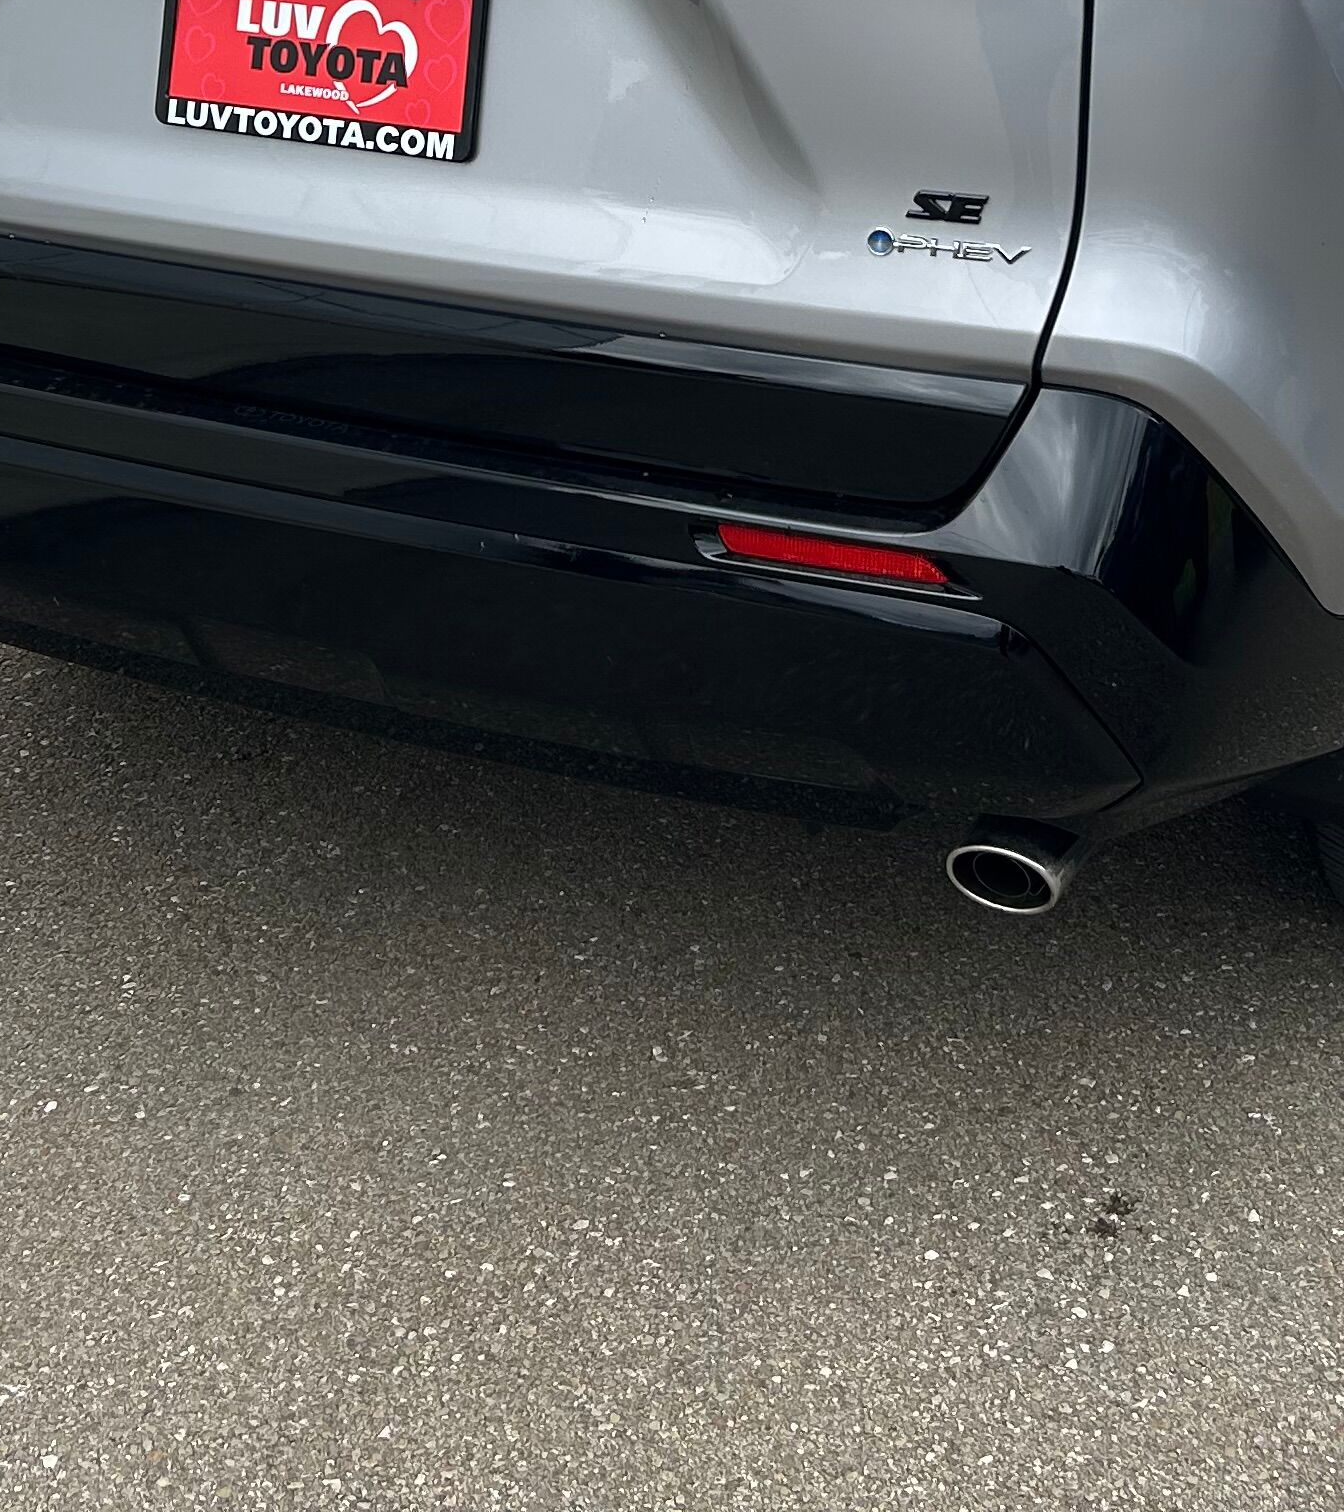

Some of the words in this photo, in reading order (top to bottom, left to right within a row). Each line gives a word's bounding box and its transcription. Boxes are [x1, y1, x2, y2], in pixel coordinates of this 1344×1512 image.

[247, 35, 408, 88] TOYOTA
[279, 82, 350, 102] LAKEWOOD
[167, 98, 455, 161] LUVTOYOTA.COM
[905, 189, 990, 225] SE
